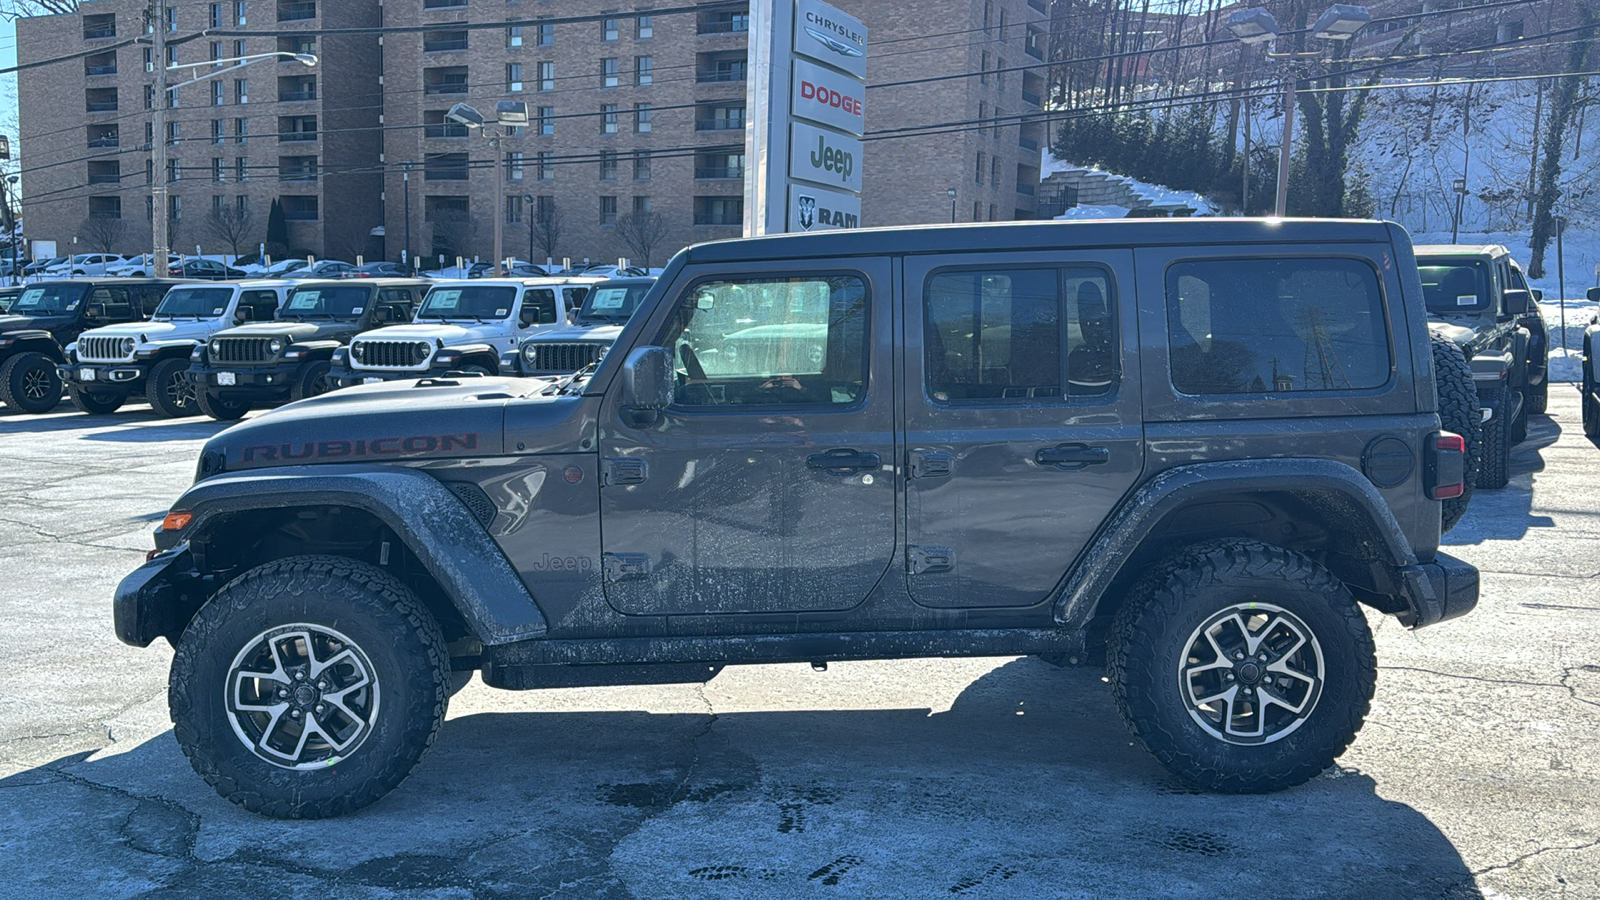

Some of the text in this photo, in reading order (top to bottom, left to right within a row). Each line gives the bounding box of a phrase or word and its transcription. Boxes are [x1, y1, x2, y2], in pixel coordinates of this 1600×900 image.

[806, 12, 864, 46] CHRYSLER
[801, 81, 862, 116] DODGE
[810, 135, 853, 182] Jeep
[818, 207, 857, 229] RAM
[242, 433, 478, 462] RUBICON
[533, 552, 592, 574] Jeep
